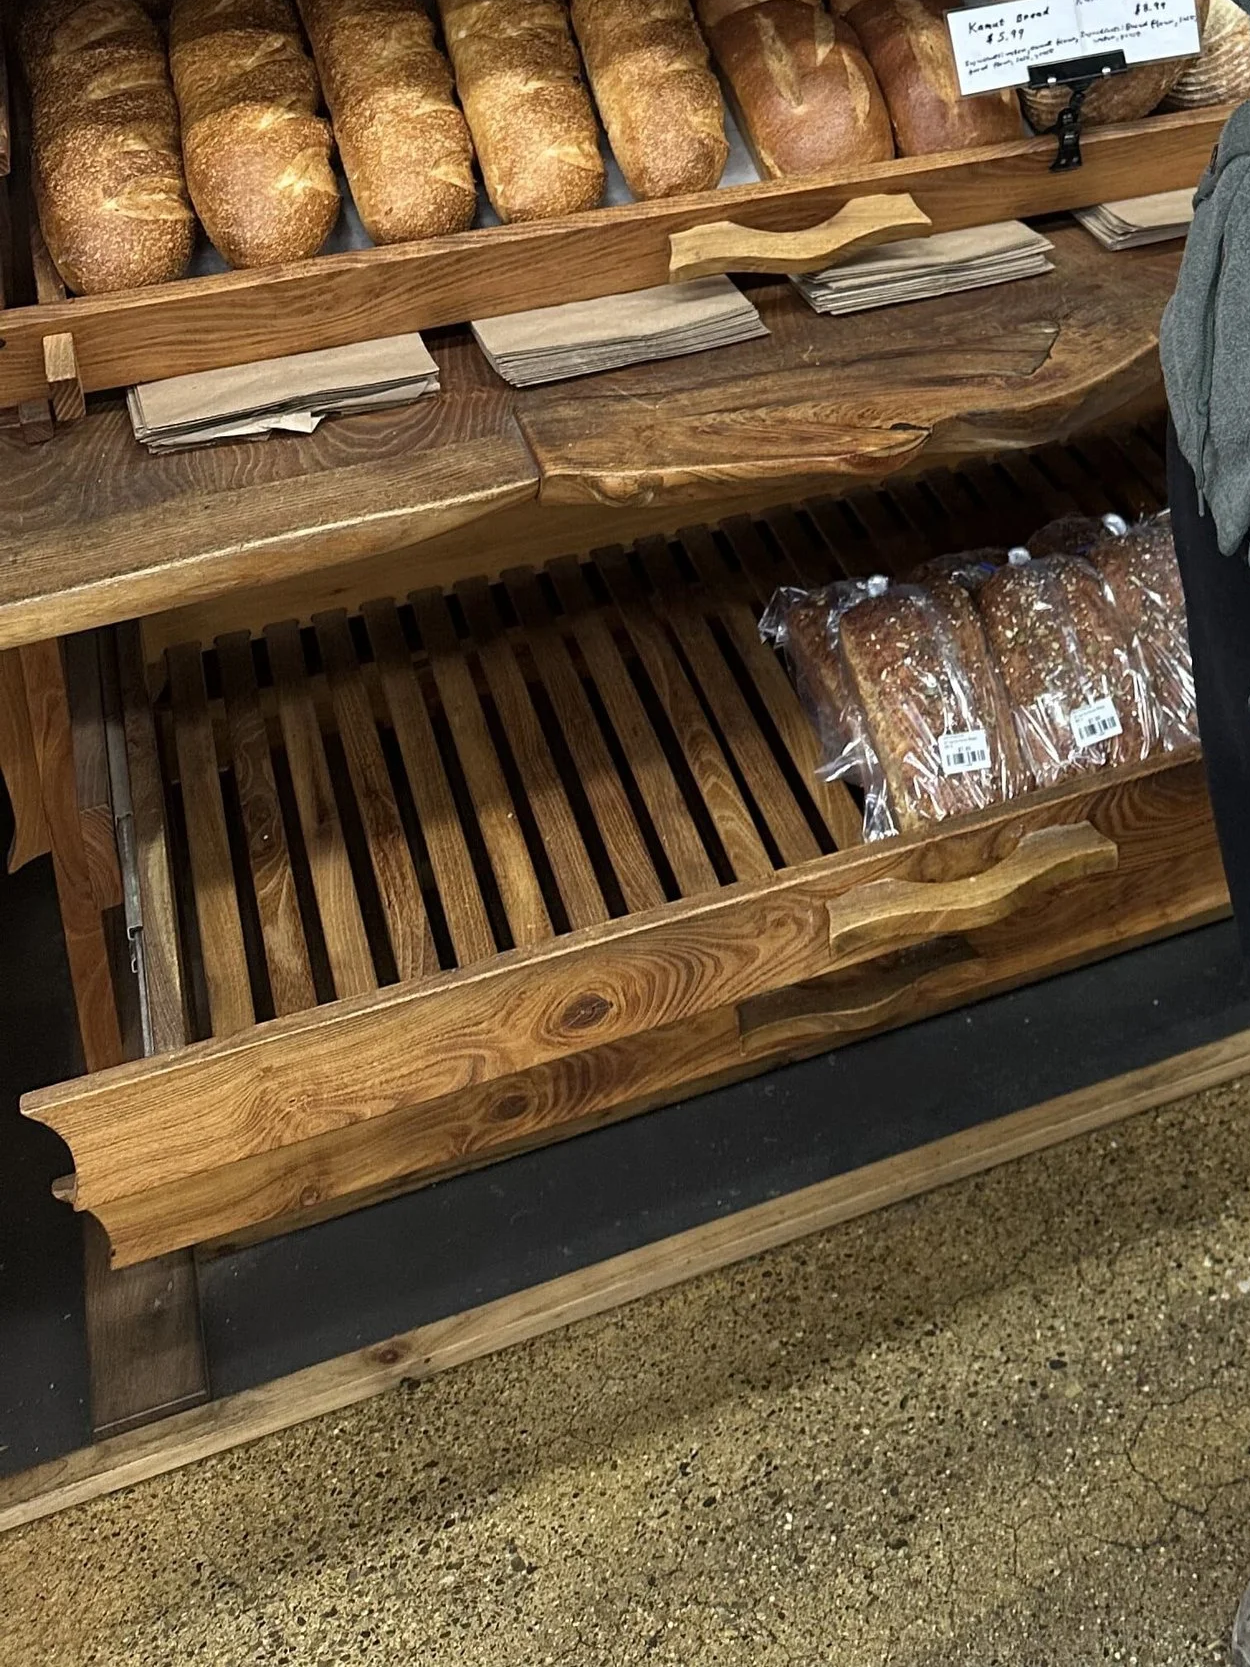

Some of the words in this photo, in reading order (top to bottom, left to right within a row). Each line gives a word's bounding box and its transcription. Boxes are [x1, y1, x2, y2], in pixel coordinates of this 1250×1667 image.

[968, 18, 1006, 34] Kamut
[1016, 6, 1051, 23] Bread
[986, 28, 1025, 44] $5.99
